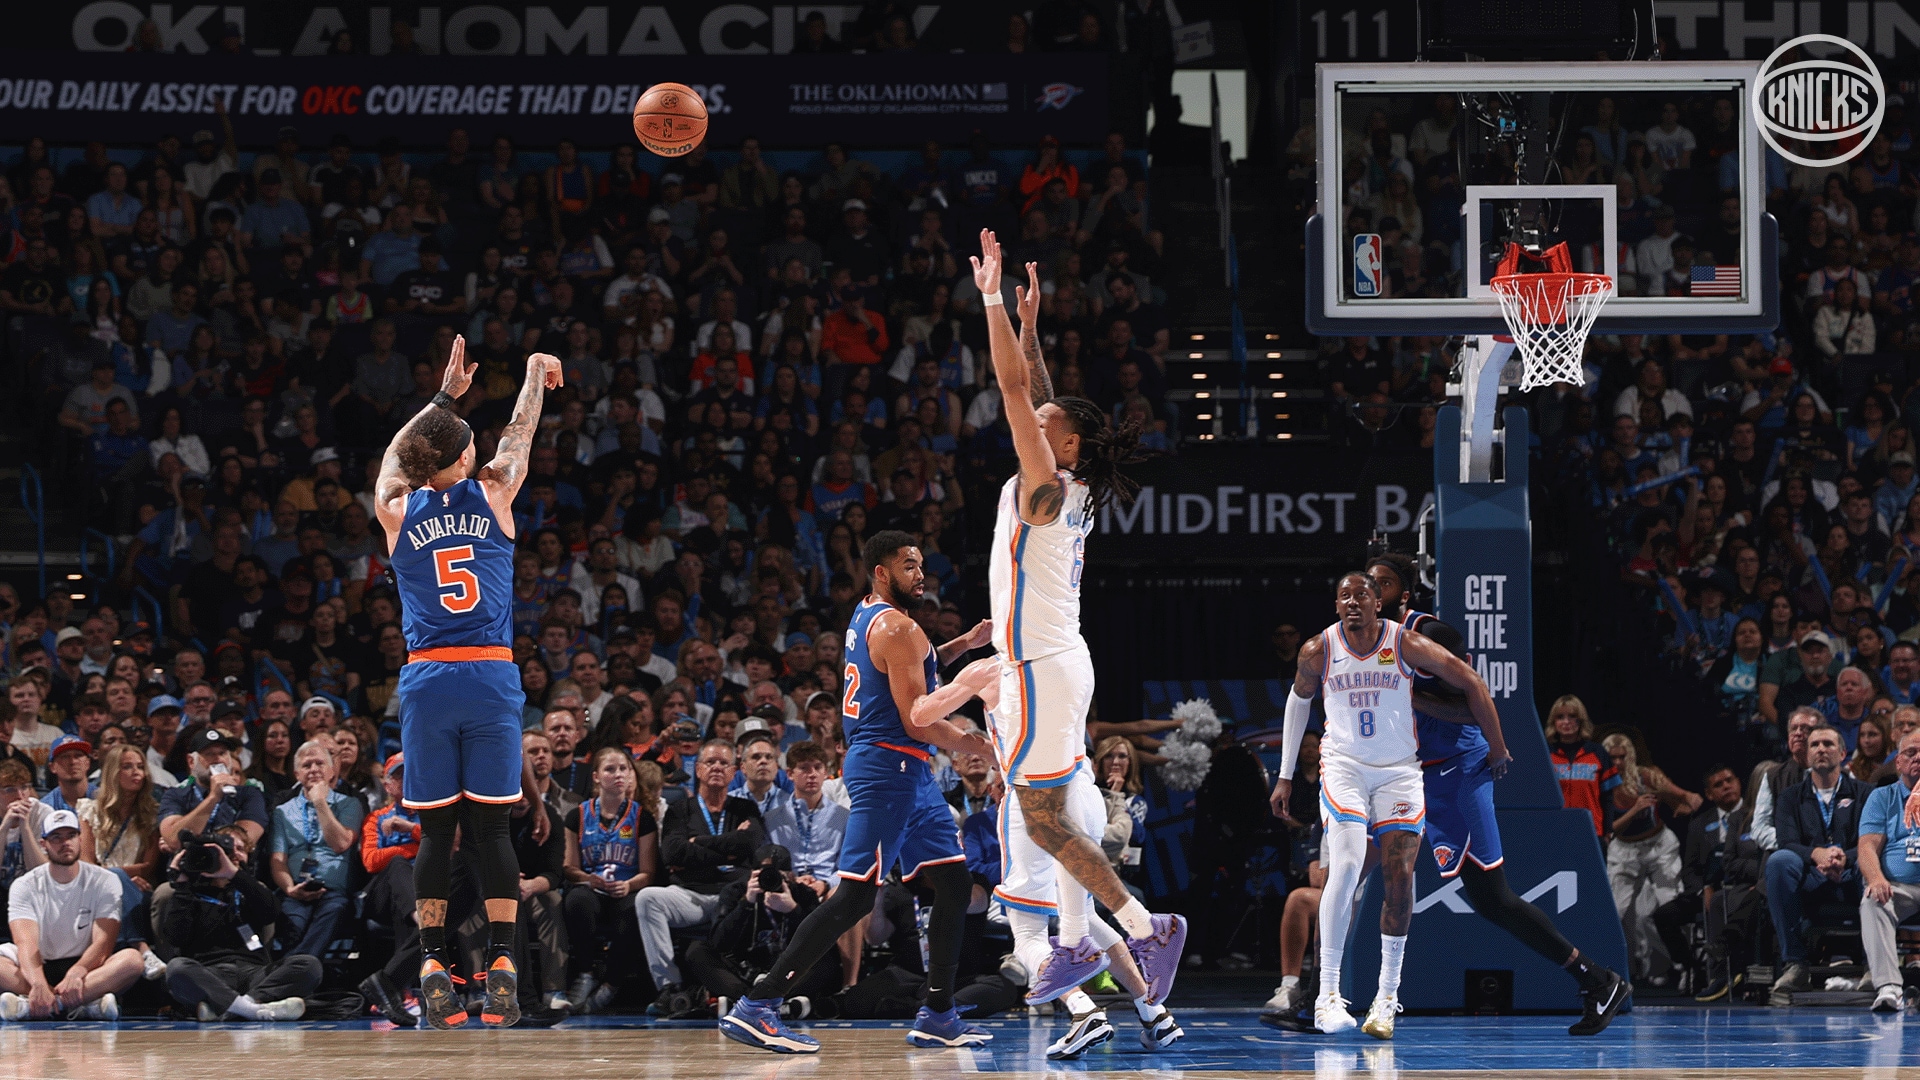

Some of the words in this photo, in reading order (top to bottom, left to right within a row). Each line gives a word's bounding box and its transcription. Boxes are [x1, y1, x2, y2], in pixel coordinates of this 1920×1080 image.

[1310, 9, 1389, 59] 111
[56, 80, 141, 111] DAILY
[139, 82, 239, 114] ASSIST
[239, 84, 298, 115] FOR
[302, 84, 363, 115] OKC
[364, 84, 514, 115] COVERAGE
[518, 84, 590, 114] THAT
[789, 84, 833, 101] THE
[837, 84, 979, 101] OKLAHOMAN
[1358, 281, 1372, 292] NBA
[407, 513, 491, 551] ALVARADO
[432, 544, 481, 614] 5
[1464, 574, 1507, 611] GET
[1464, 613, 1508, 649] THE
[843, 662, 861, 719] 2
[1327, 670, 1402, 693] OKLAHOMA
[1476, 653, 1518, 699] App
[1348, 690, 1381, 708] CITY
[1358, 708, 1376, 739] 8
